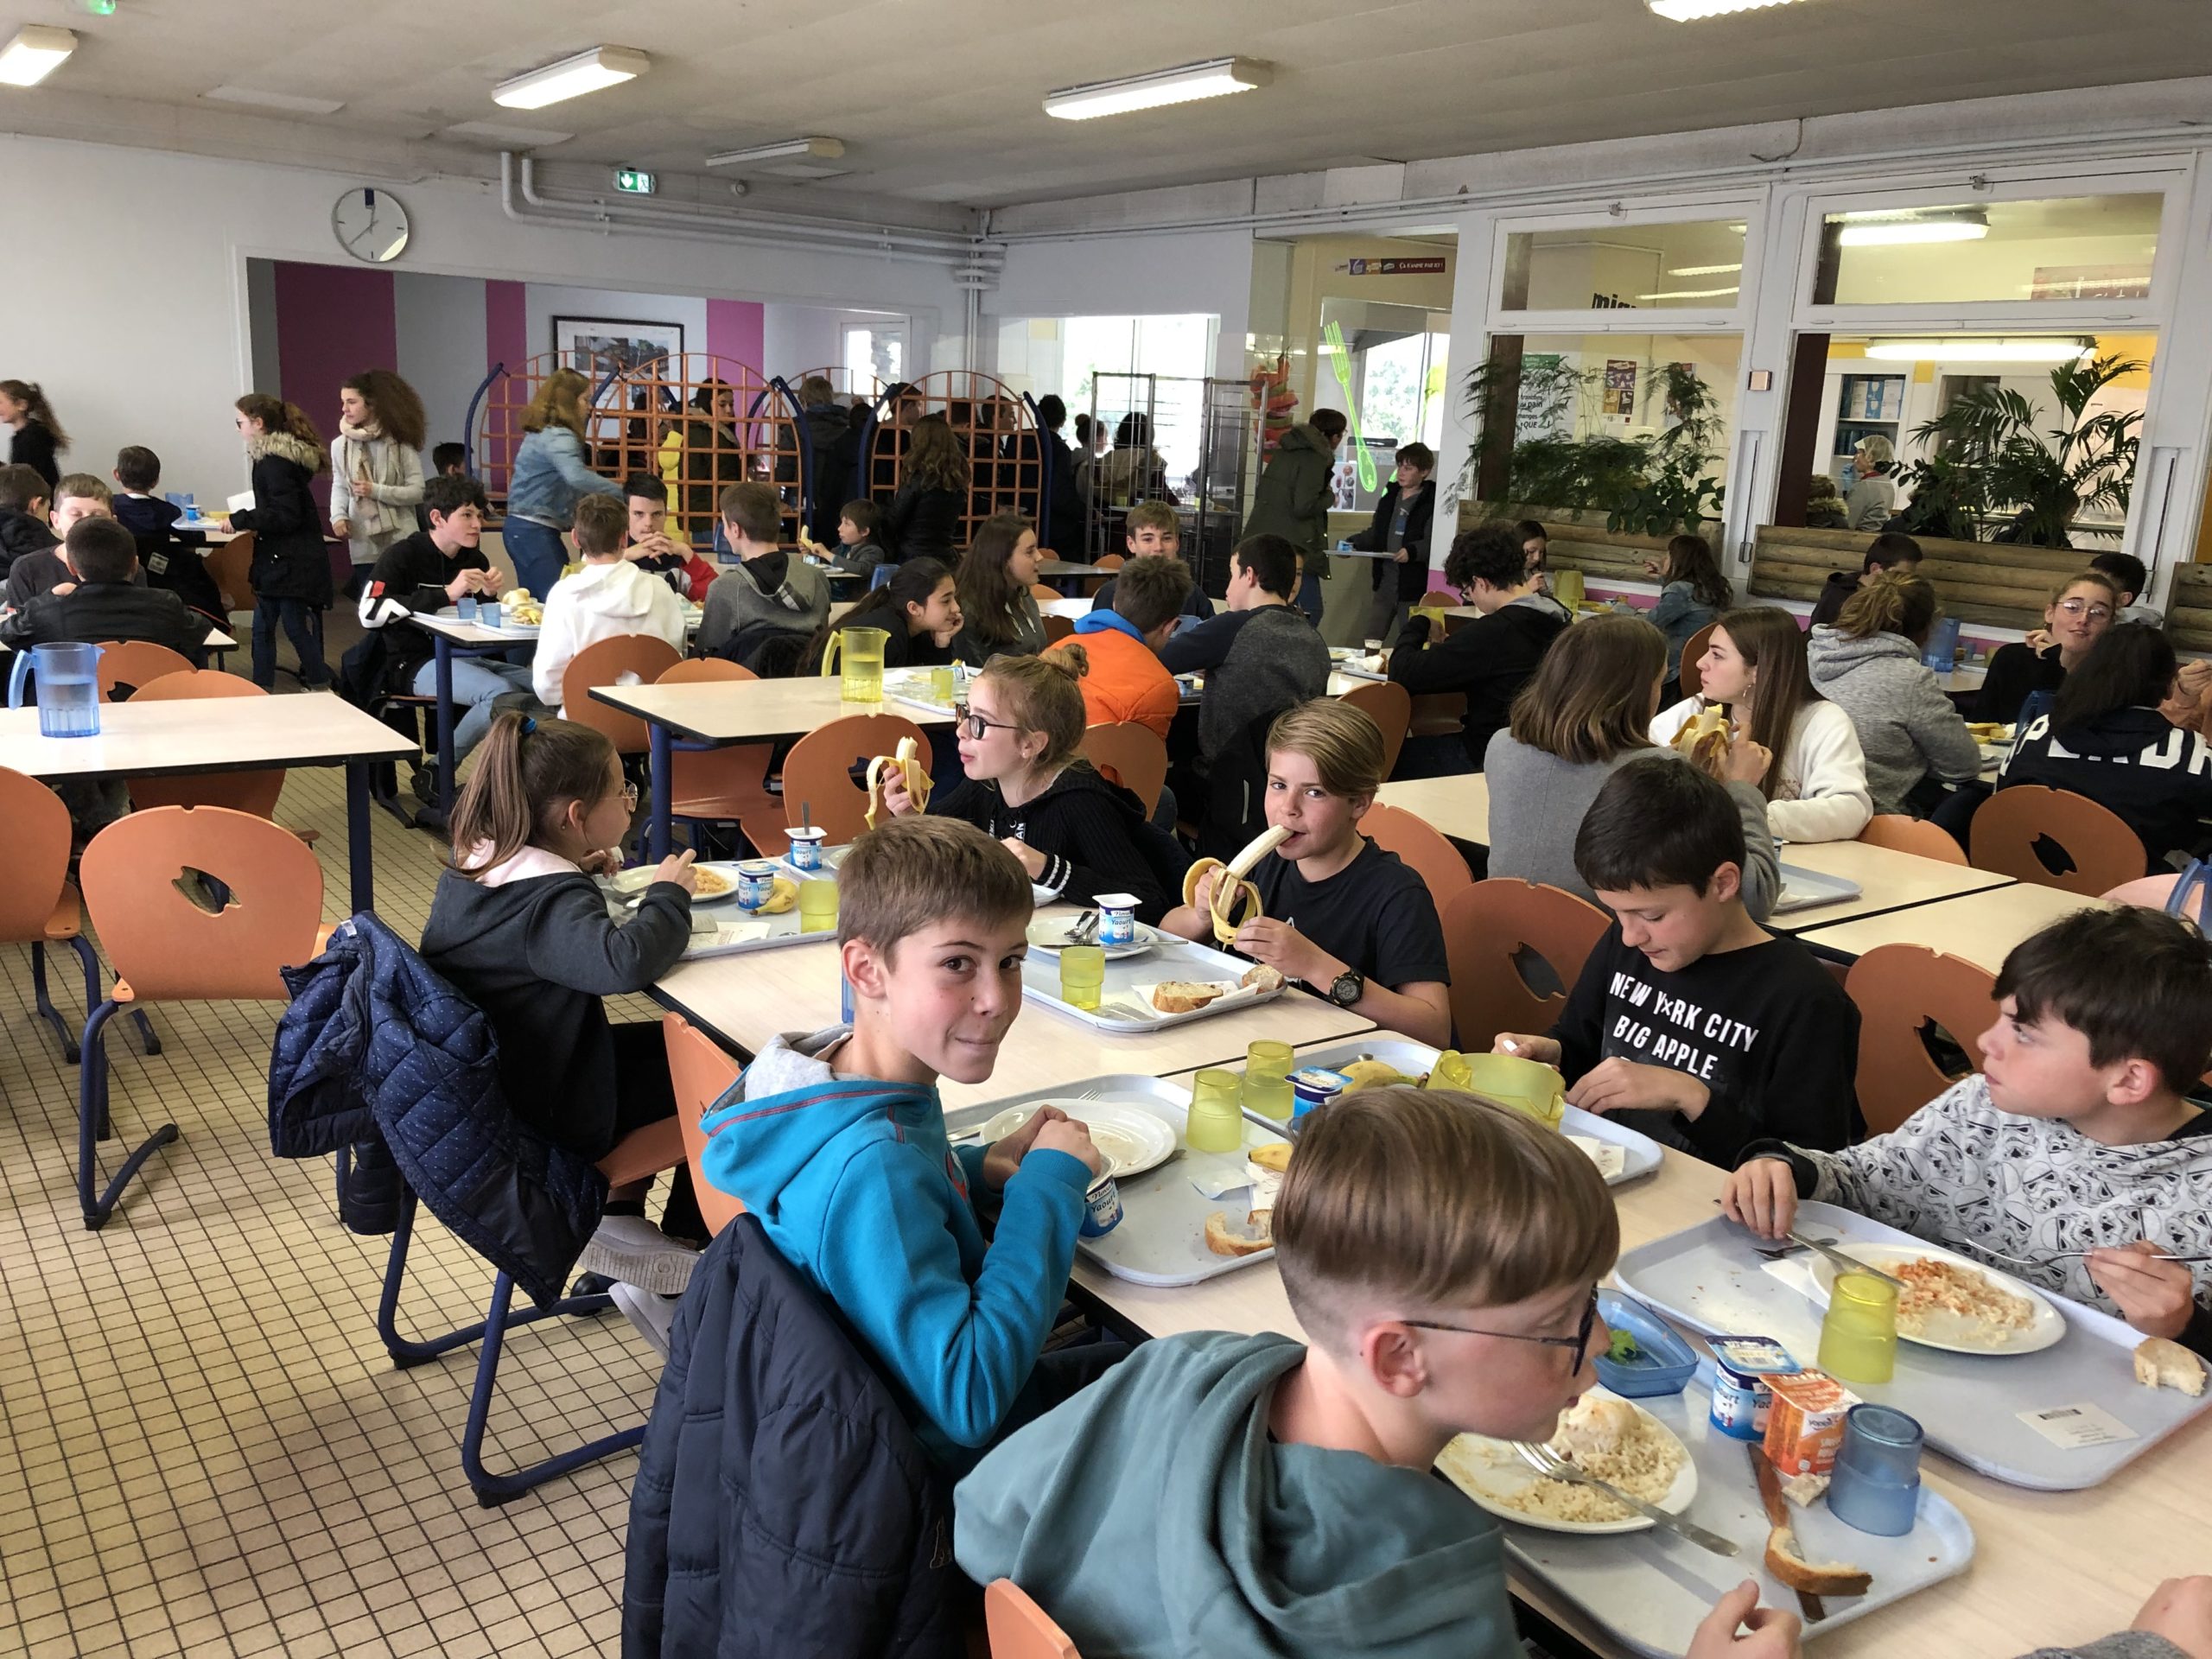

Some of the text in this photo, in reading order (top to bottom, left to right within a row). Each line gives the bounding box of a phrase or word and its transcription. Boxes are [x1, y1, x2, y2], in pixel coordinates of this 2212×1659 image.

[1528, 401, 1543, 410] pain
[1609, 971, 1653, 1007] NEW
[1703, 1013, 1760, 1052] CITY
[1612, 1014, 1719, 1080] BIG APPLE
[1091, 1192, 1116, 1213] Yaourt
